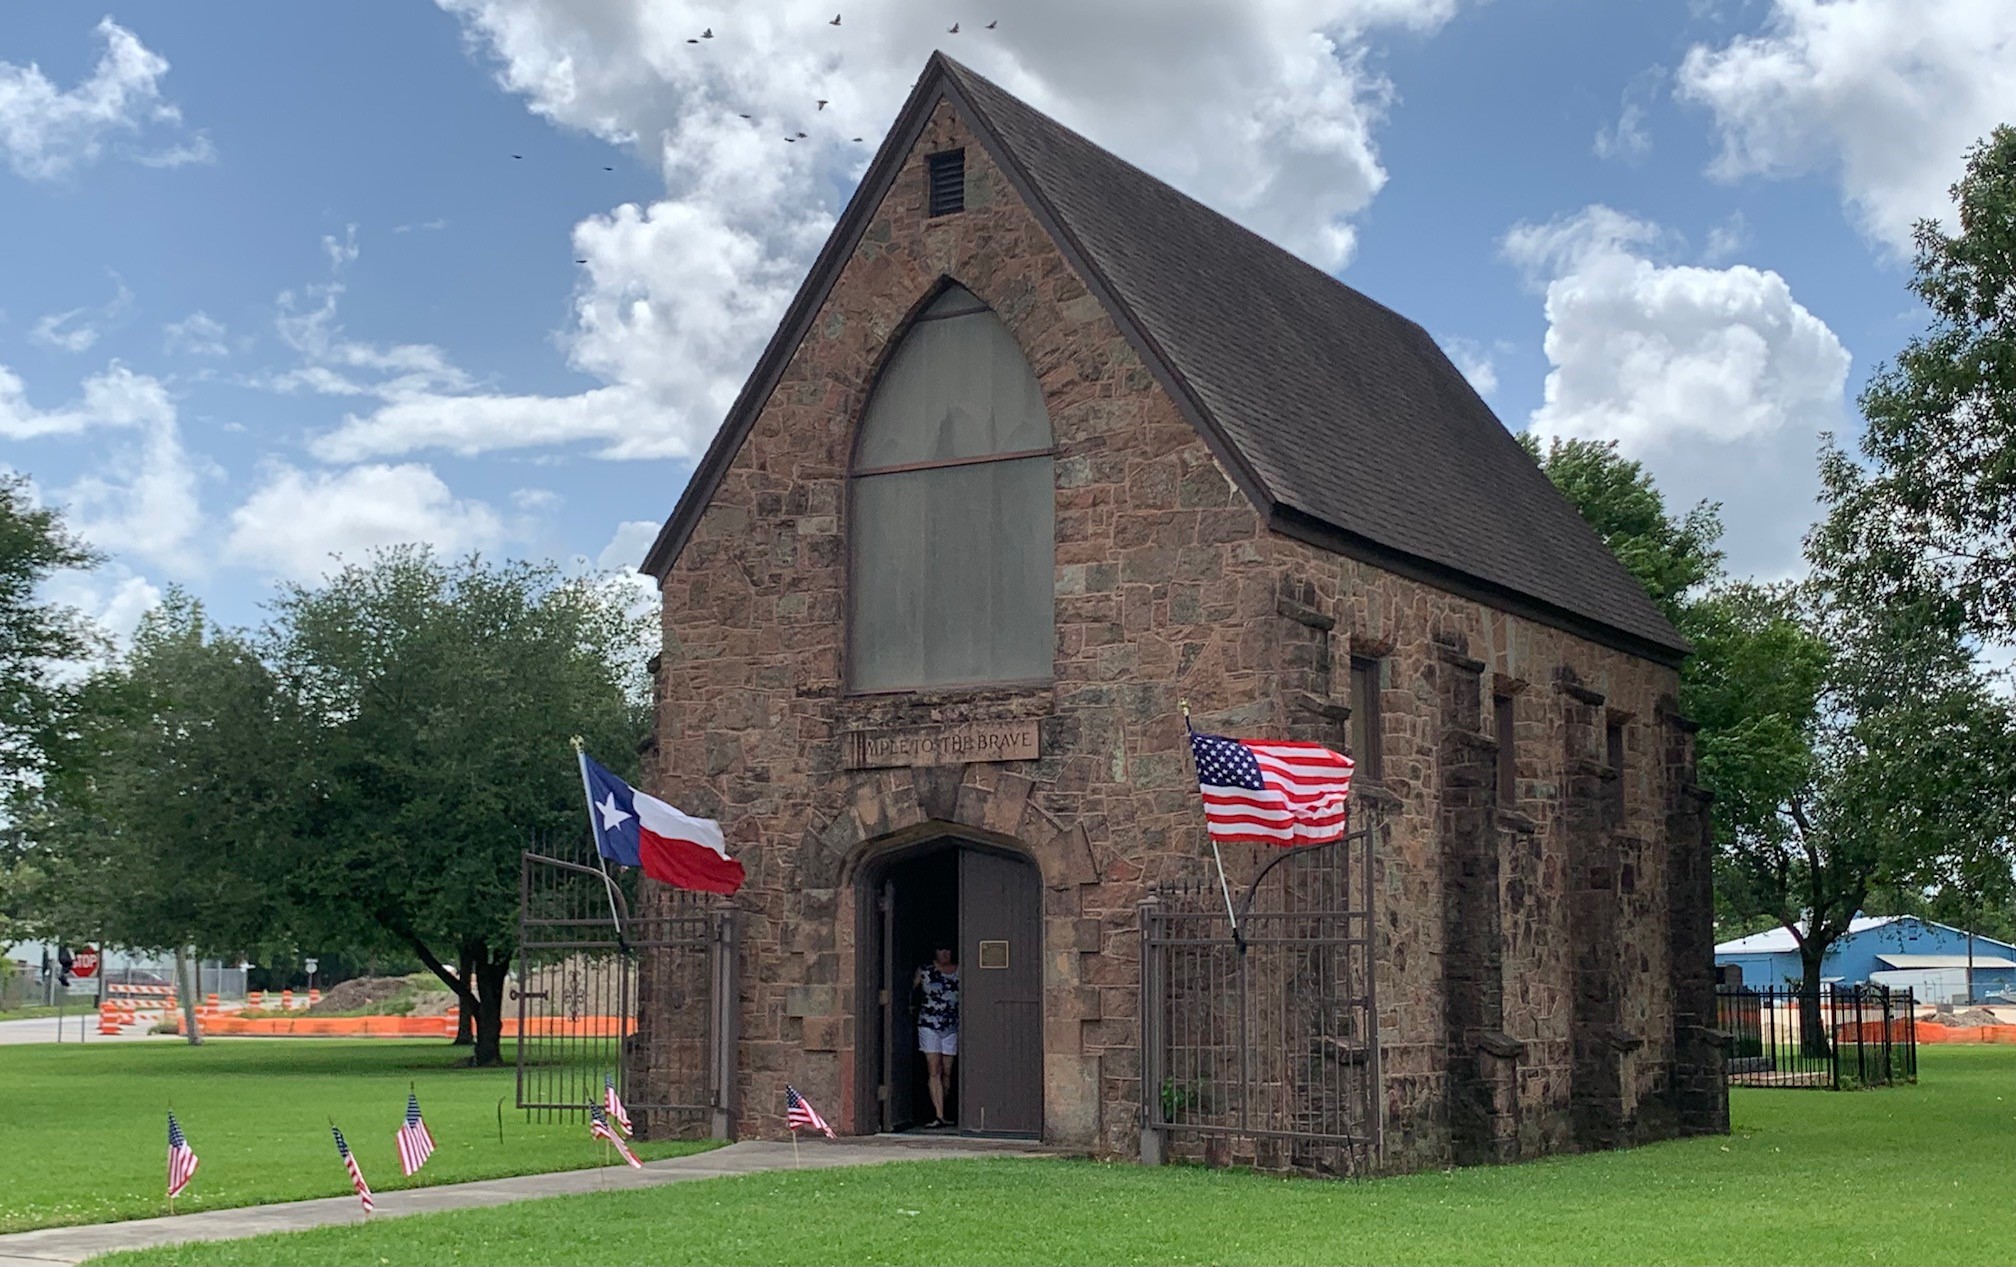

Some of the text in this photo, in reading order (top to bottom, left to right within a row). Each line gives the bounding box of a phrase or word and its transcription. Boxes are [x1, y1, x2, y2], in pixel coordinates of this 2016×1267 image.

[912, 737, 934, 754] TO
[941, 733, 975, 753] THE
[977, 732, 1032, 751] BRAVE
[73, 953, 97, 968] STOP
